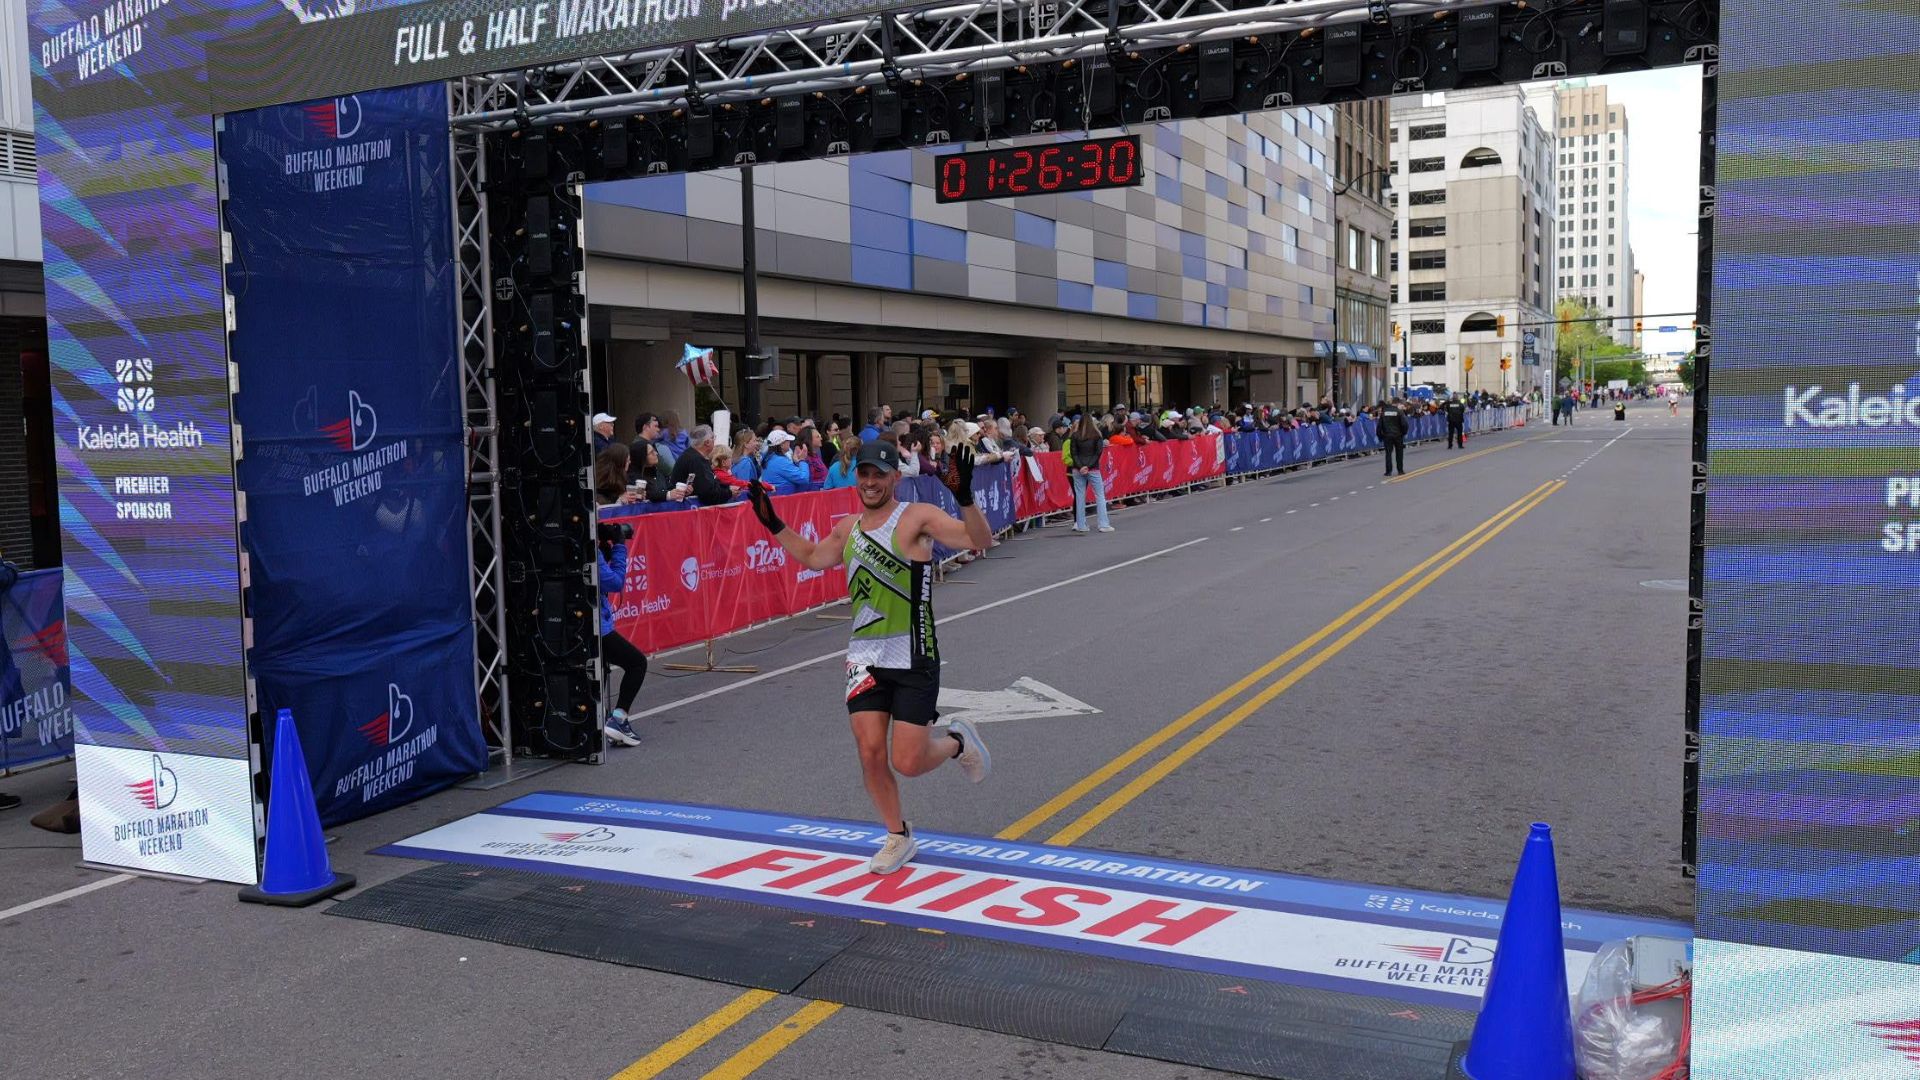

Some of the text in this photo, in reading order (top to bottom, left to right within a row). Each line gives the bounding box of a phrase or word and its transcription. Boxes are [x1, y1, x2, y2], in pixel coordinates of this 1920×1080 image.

[42, 0, 169, 68] BUFFALO MARA
[77, 24, 142, 80] WEEKEND
[394, 20, 449, 66] FULL
[458, 20, 476, 55] &
[485, 3, 549, 50] HALF
[285, 139, 391, 175] BUFFALO MARATHON
[942, 140, 1134, 198] 01:26:30
[314, 165, 363, 192] WEEKEND
[78, 421, 202, 450] Kaleida Health
[115, 476, 169, 494] PREMIER
[303, 463, 350, 497] BUFFALO
[352, 439, 408, 477] MARATHON
[333, 471, 382, 507] WEEKEND
[116, 502, 172, 519] SPONSOR
[641, 594, 671, 614] Health
[0, 681, 64, 735] UFFALO
[38, 707, 72, 746] WEE
[335, 723, 437, 798] BUFFALO MARATHON
[363, 760, 414, 803] WEEKEND
[115, 808, 208, 841] BUFFALO MARATHON
[139, 834, 183, 857] WEEKEND
[481, 841, 633, 854] BUFFALO MARATHON
[775, 823, 873, 842] 2025
[1031, 853, 1264, 893] MARATHON
[692, 849, 1239, 946] FINISH
[1420, 903, 1500, 920] Kaleida
[1335, 958, 1429, 974] BUFFALO
